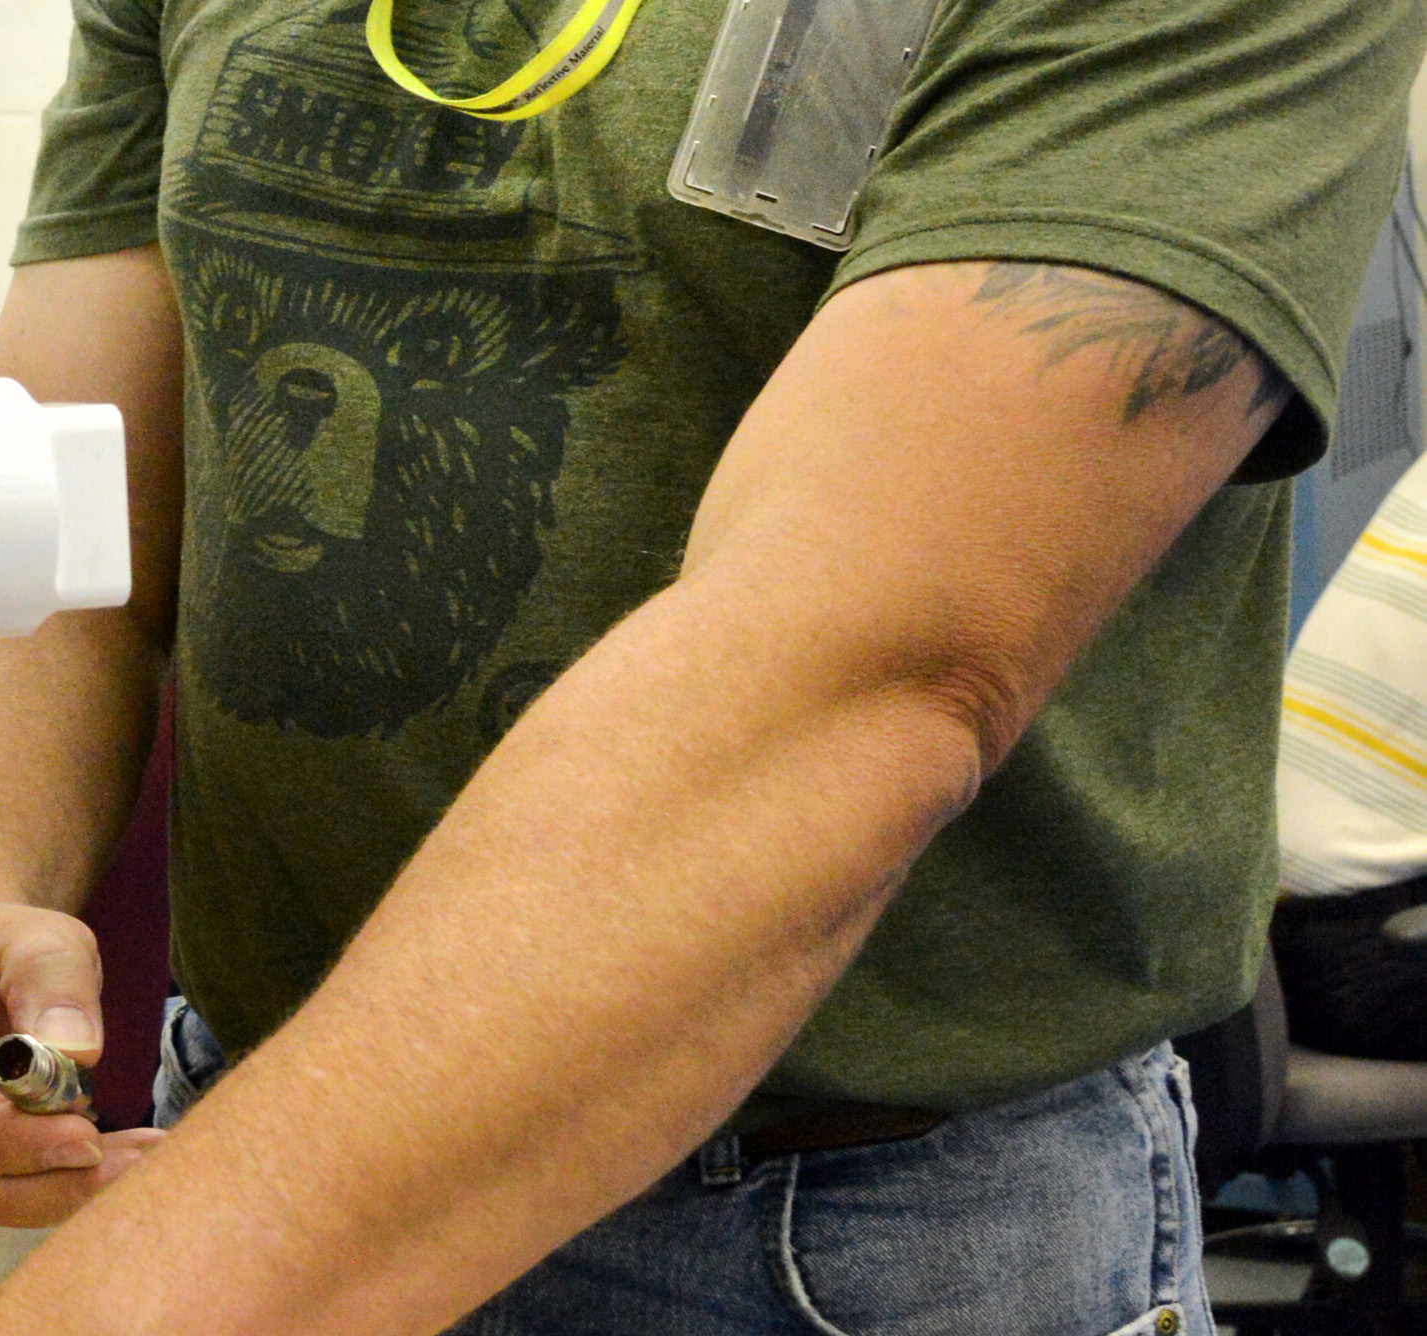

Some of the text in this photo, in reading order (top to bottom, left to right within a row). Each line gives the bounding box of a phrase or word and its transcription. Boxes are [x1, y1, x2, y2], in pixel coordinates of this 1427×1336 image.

[523, 25, 606, 102] Reflective Material
[226, 71, 525, 192] SMOKEY
